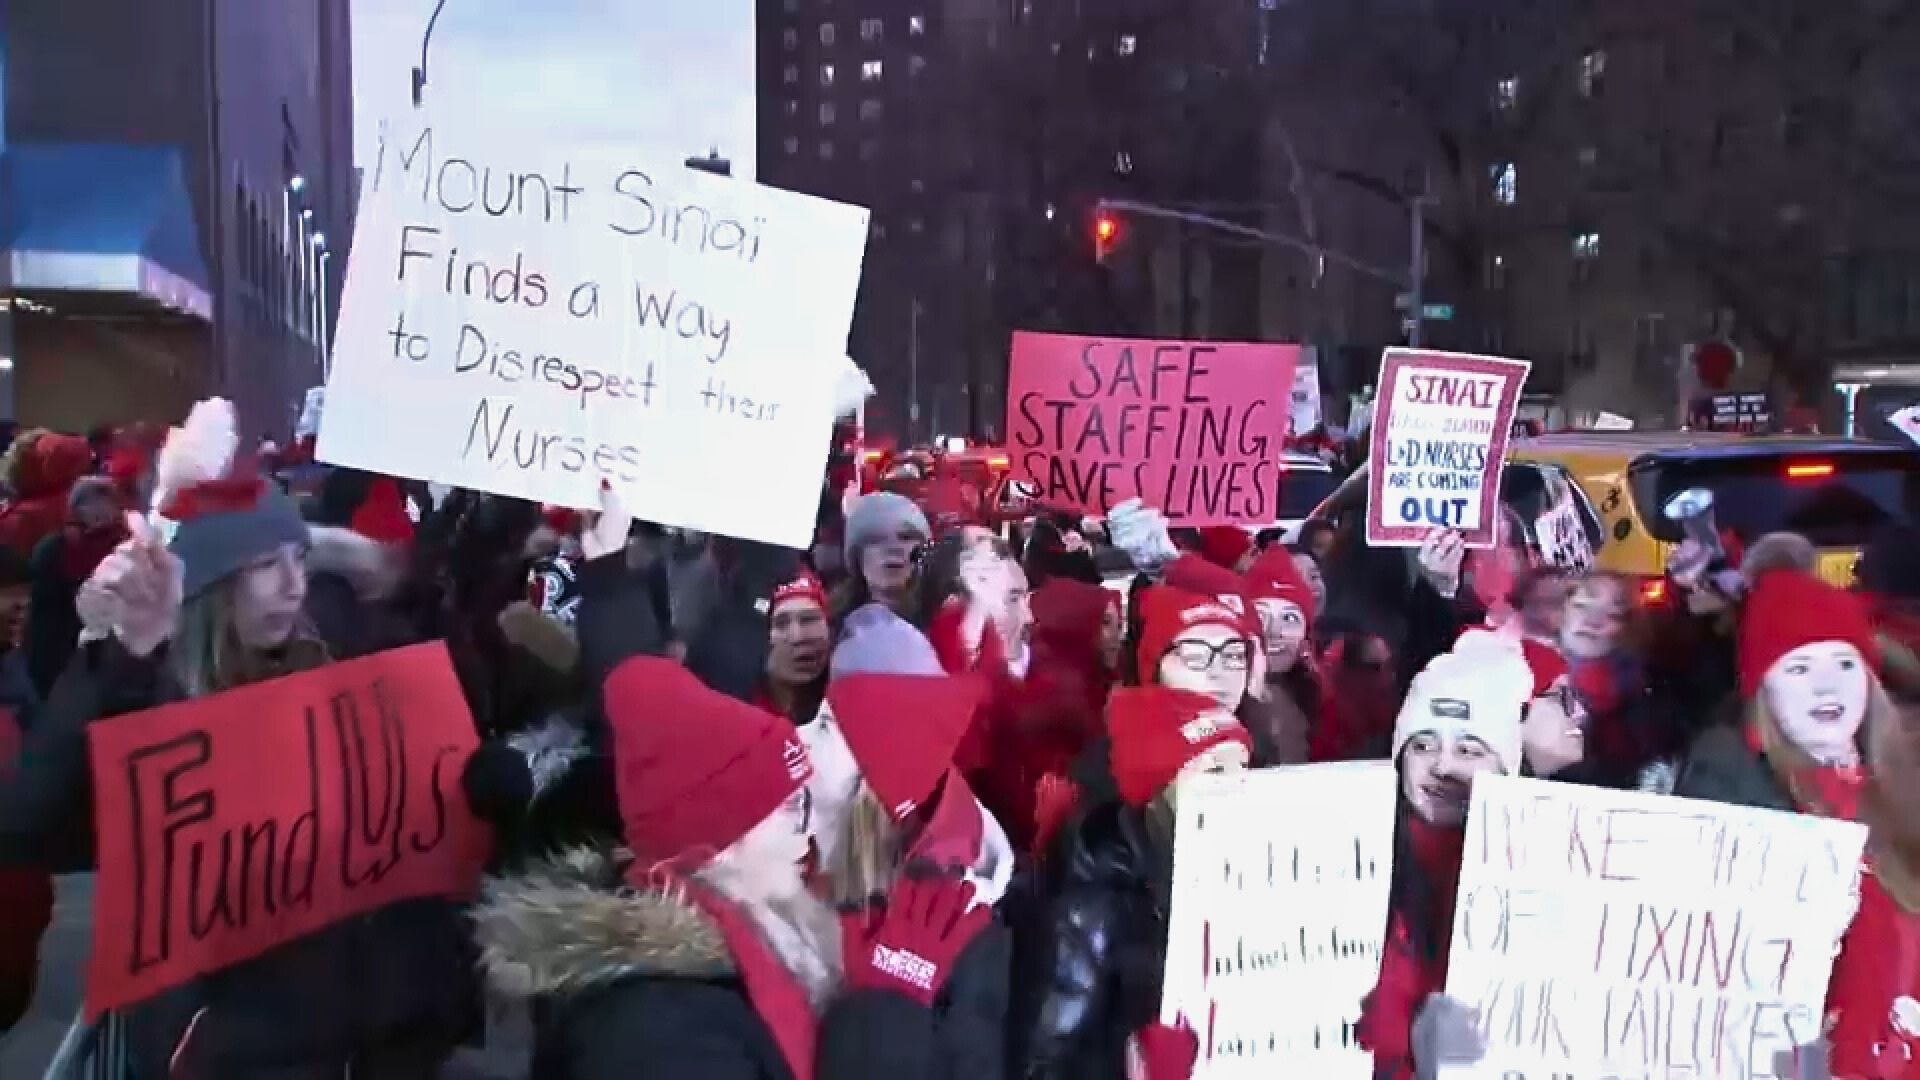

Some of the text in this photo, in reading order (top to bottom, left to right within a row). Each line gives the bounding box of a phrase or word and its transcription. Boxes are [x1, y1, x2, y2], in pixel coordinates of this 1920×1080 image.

[374, 125, 769, 263] Mount Sinai
[396, 224, 731, 364] Finds a Way
[388, 312, 781, 422] to Disrespect their
[1070, 343, 1218, 404] SAFE
[1407, 374, 1498, 408] SINAI
[461, 397, 642, 483] Nurses
[1015, 391, 1269, 460] STAFFING
[1423, 440, 1487, 472] NURSES
[1162, 458, 1271, 520] LIVES
[1401, 497, 1469, 527] OUT
[127, 681, 460, 976] Fund Us
